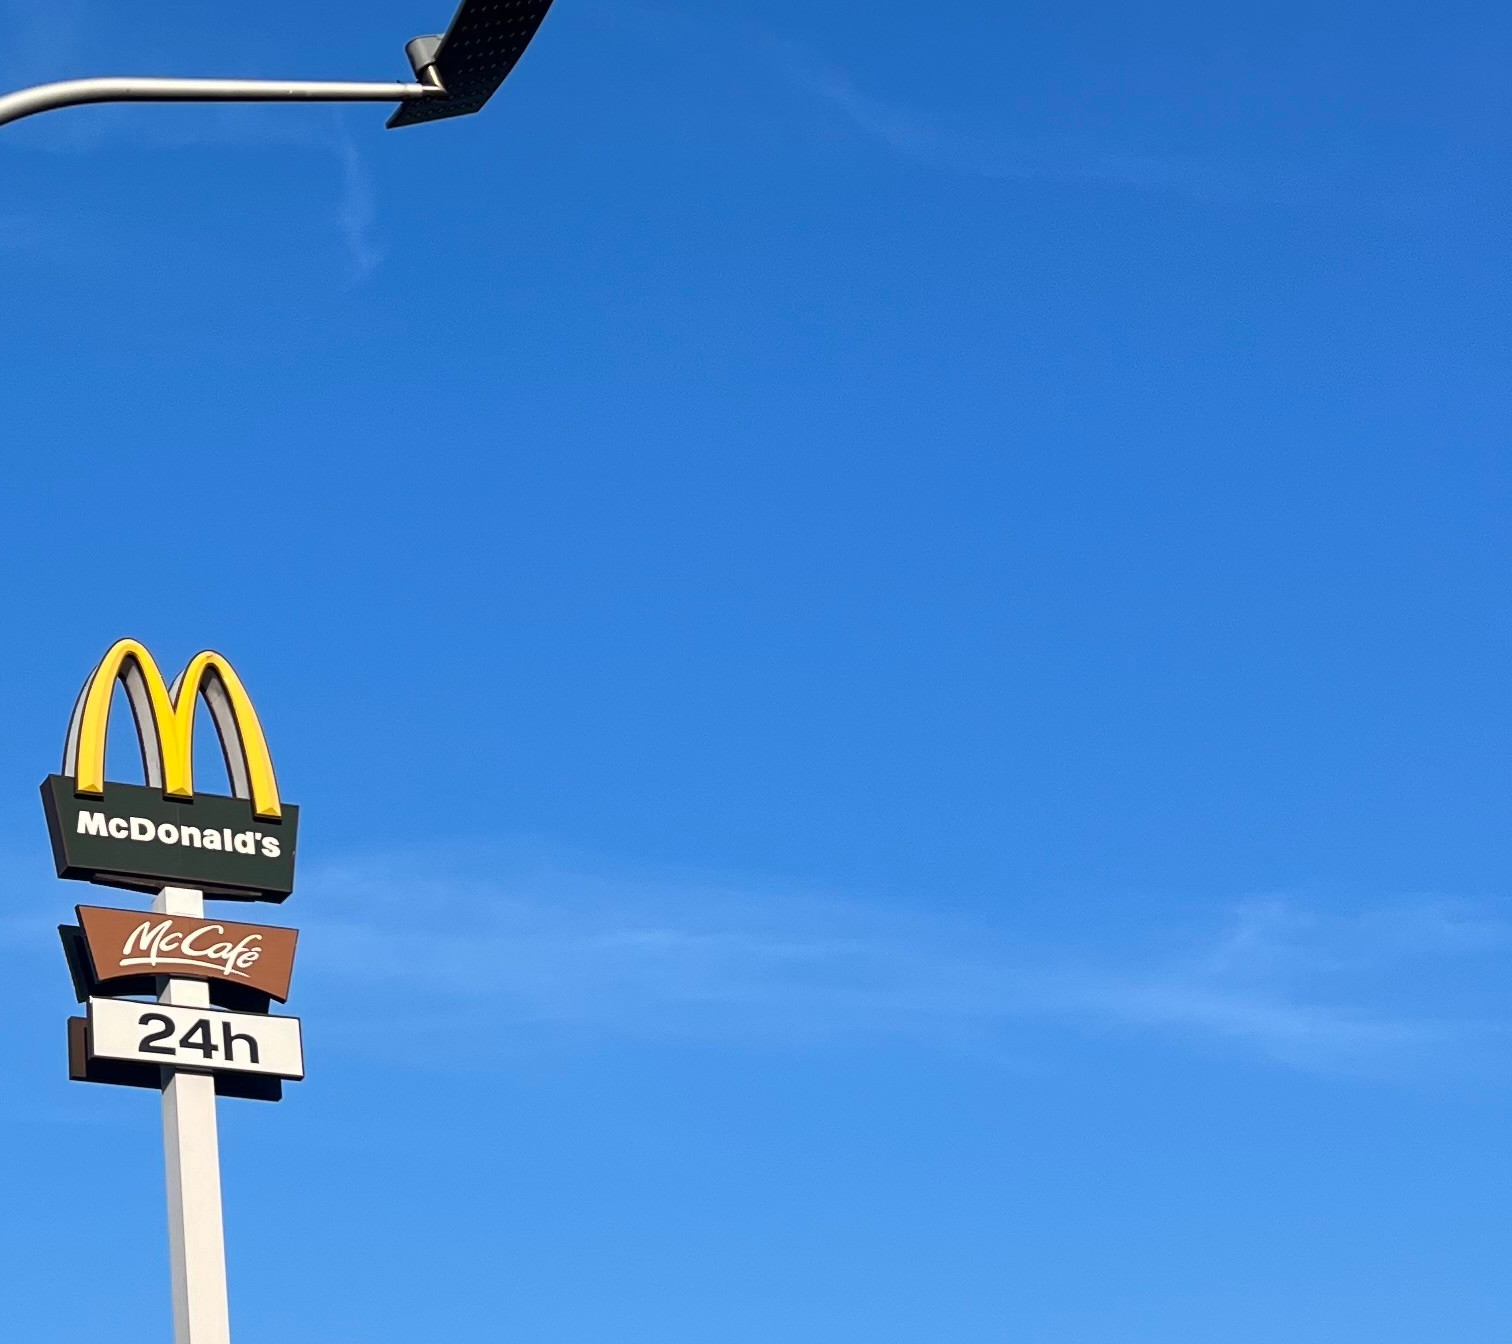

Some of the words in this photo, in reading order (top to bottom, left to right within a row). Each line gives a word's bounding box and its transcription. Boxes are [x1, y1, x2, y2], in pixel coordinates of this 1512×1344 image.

[76, 809, 282, 858] McDonald's
[120, 920, 263, 977] McCafé
[137, 1012, 261, 1065] 24h
